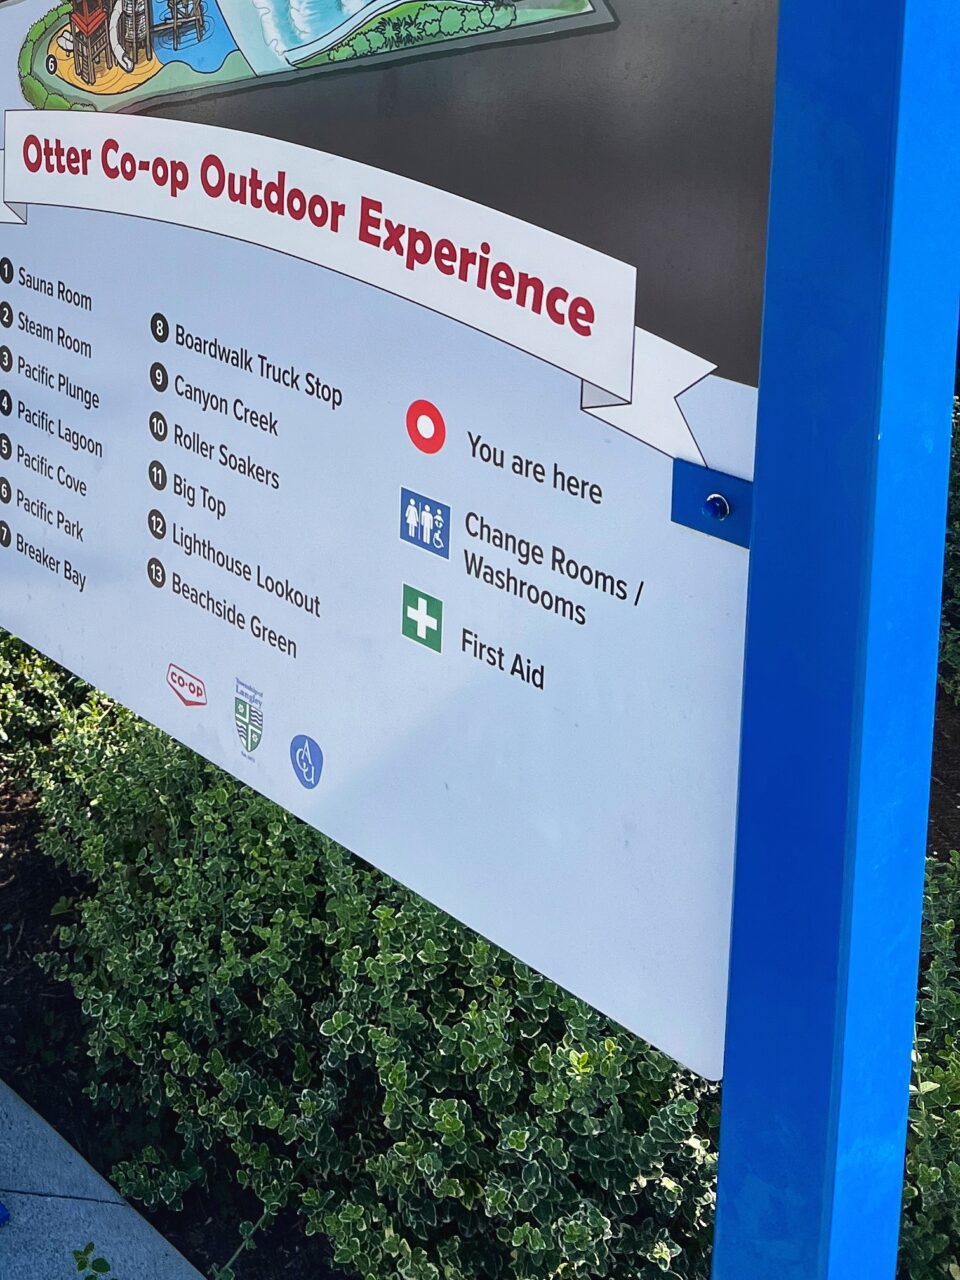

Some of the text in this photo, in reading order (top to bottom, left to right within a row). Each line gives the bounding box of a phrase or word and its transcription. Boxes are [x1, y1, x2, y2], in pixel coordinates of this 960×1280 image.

[22, 133, 596, 337] Otter Co-op Outdoor Experience
[18, 267, 54, 296] Sauna
[57, 281, 92, 312] Room
[18, 311, 54, 343] Steam
[57, 327, 92, 359] Room
[17, 355, 55, 389] Pacific
[58, 373, 100, 410] Plunge
[175, 324, 253, 373] Boardwalk
[257, 354, 300, 391] Truck
[304, 372, 342, 410] Stop
[17, 400, 55, 435] Pacific
[58, 419, 103, 458] Lagoon
[174, 374, 228, 415] Canyon
[233, 399, 279, 436] Creek
[17, 444, 54, 480] Pacific
[57, 465, 87, 496] Cove
[174, 423, 215, 460] Roller
[219, 444, 280, 490] Soakers
[467, 431, 603, 505] You are here
[16, 488, 54, 525] Pacific
[57, 510, 84, 543] Park
[173, 473, 196, 508] Big
[200, 486, 226, 520] Top
[16, 533, 61, 574] Breaker
[64, 560, 87, 593] Bay
[172, 522, 252, 581] Lighthouse
[257, 565, 321, 618] Lookout
[463, 549, 587, 626] Washrooms
[464, 511, 645, 607] Change Rooms /
[172, 572, 246, 630] Beachside
[250, 615, 297, 659] Green
[461, 627, 545, 691] First Aid
